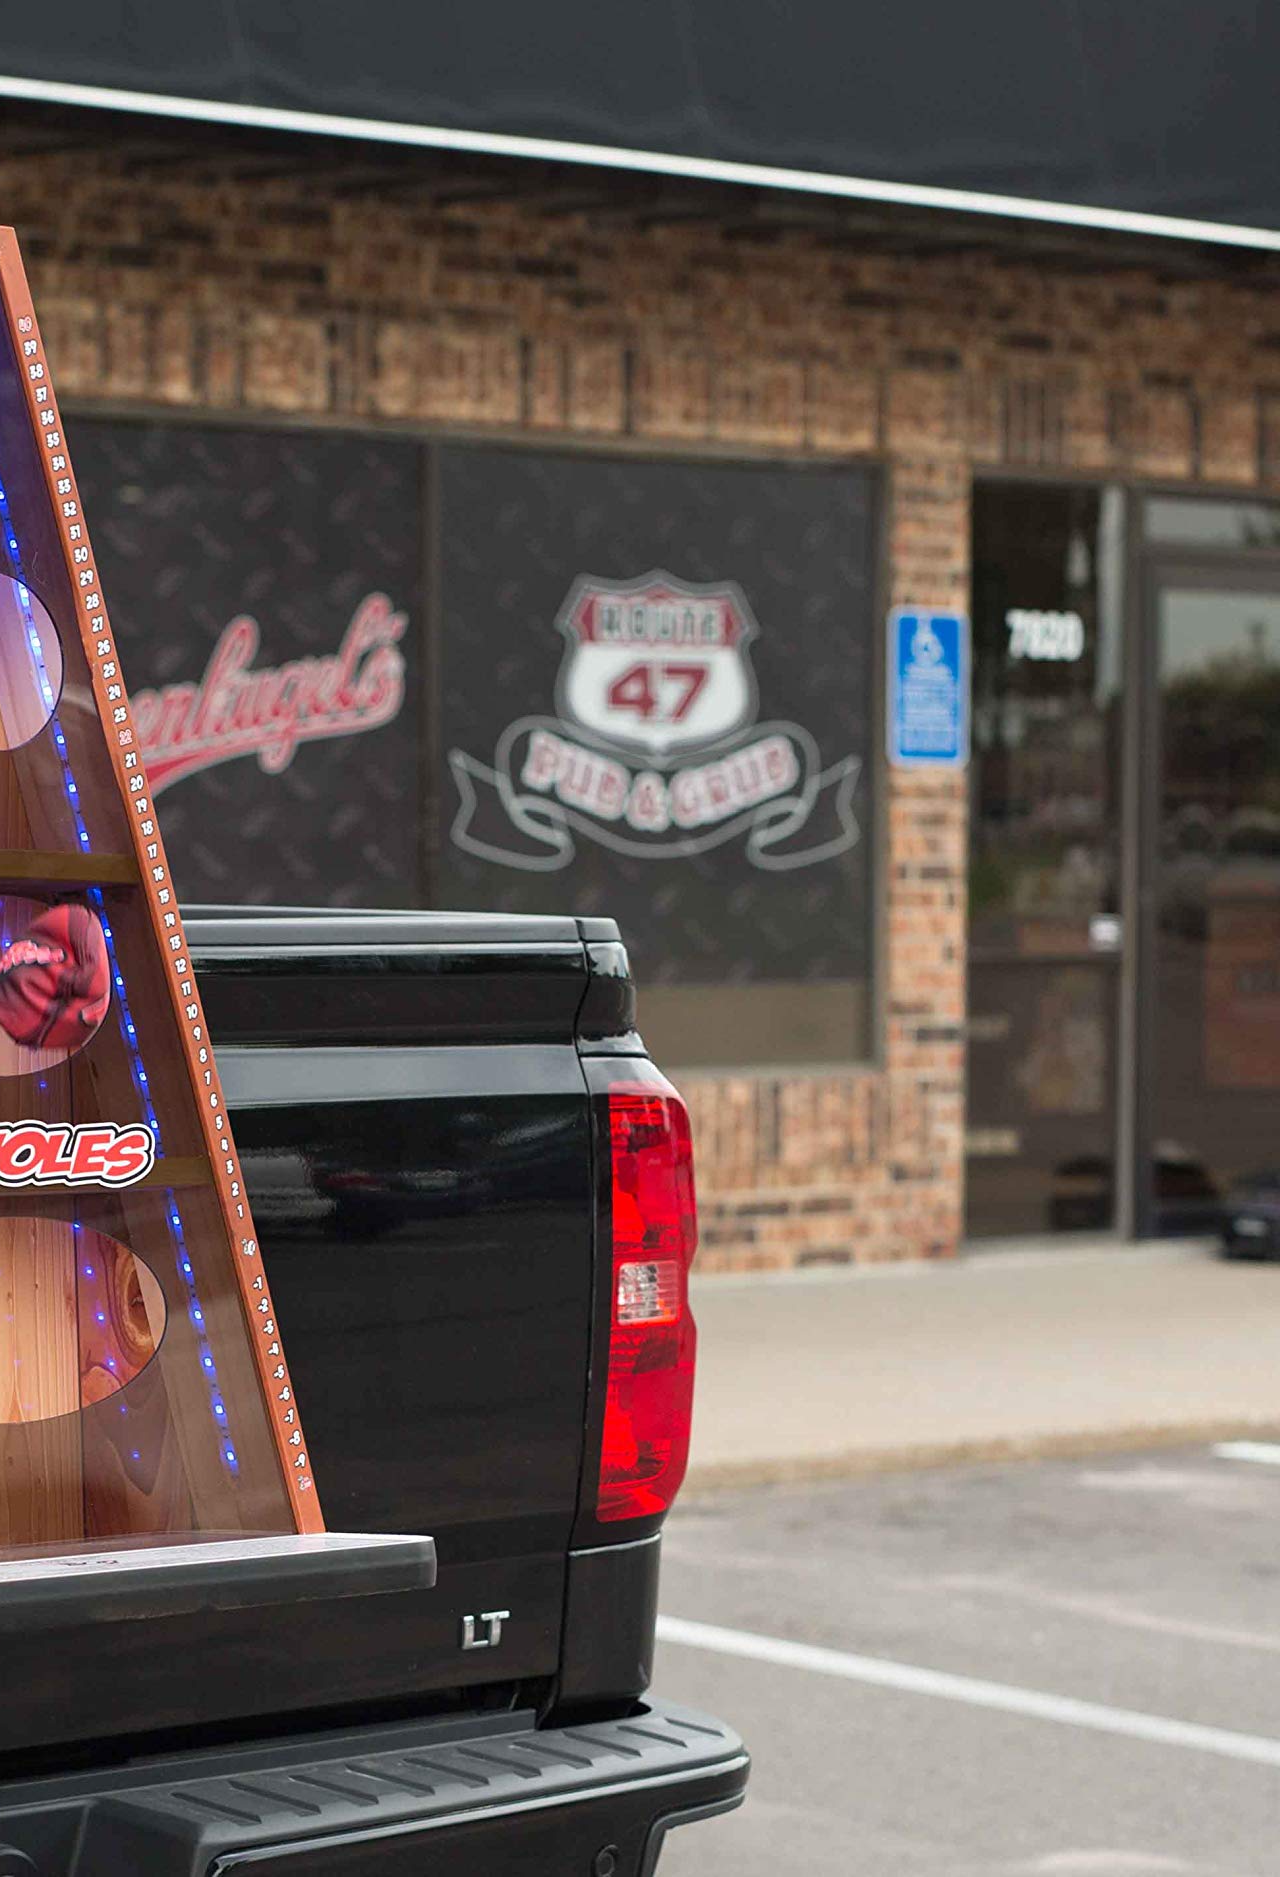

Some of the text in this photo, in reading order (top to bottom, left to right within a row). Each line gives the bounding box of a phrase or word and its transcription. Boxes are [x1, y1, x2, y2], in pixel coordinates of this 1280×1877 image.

[606, 661, 711, 724] 47
[524, 734, 629, 817] PUB
[461, 1610, 511, 1650] LT
